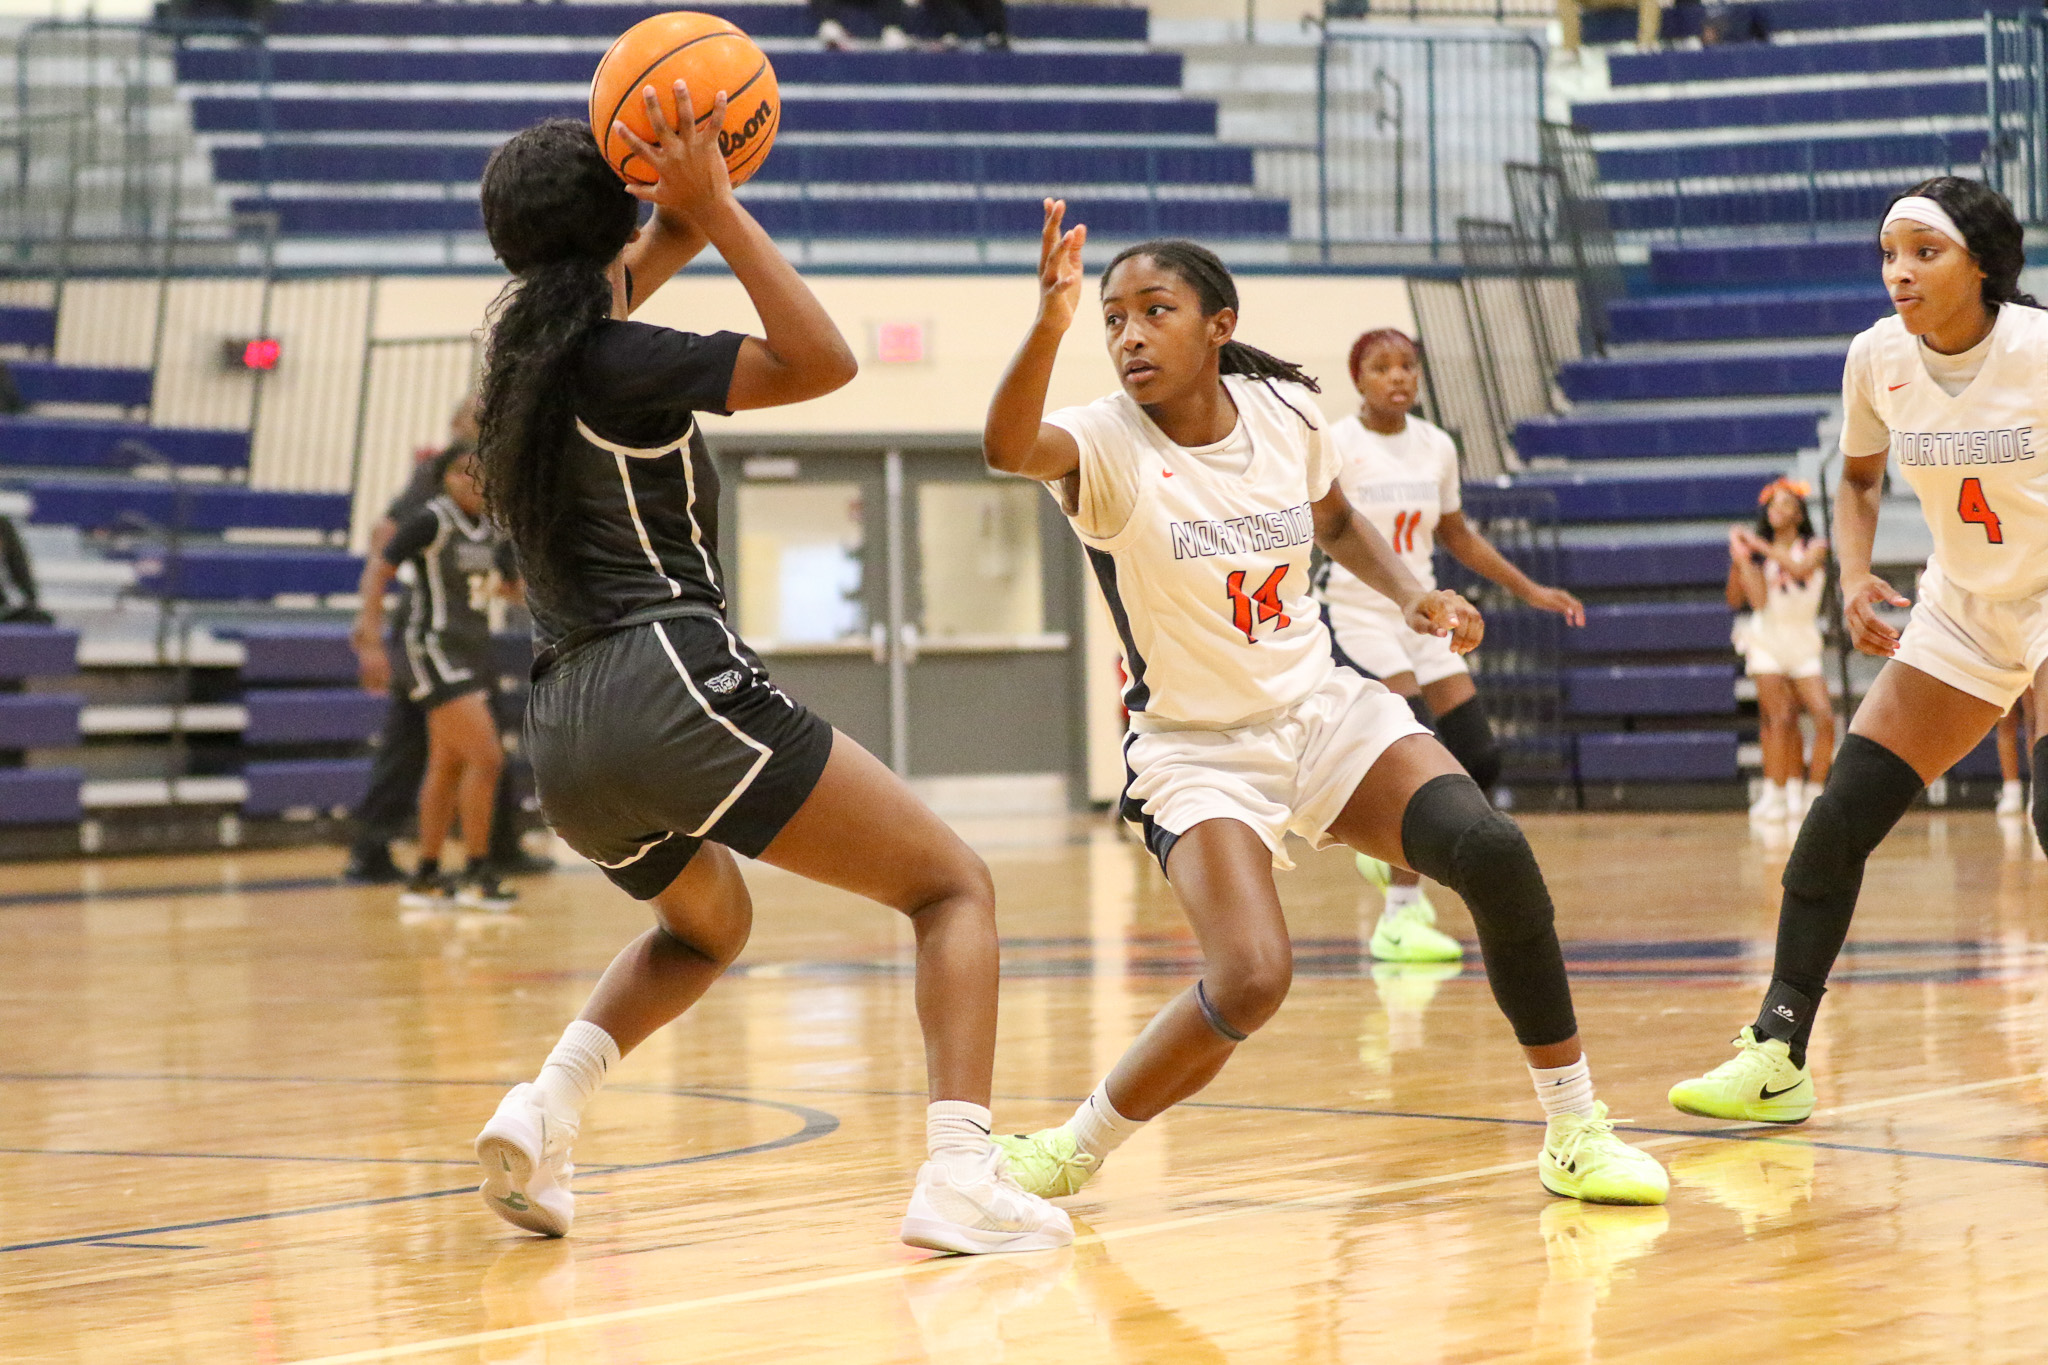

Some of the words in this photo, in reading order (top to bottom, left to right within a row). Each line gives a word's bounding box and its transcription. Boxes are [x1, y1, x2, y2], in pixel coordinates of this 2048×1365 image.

[718, 100, 772, 158] lson
[1392, 510, 1421, 554] 11
[1957, 477, 2003, 544] 4
[1226, 563, 1291, 644] 14
